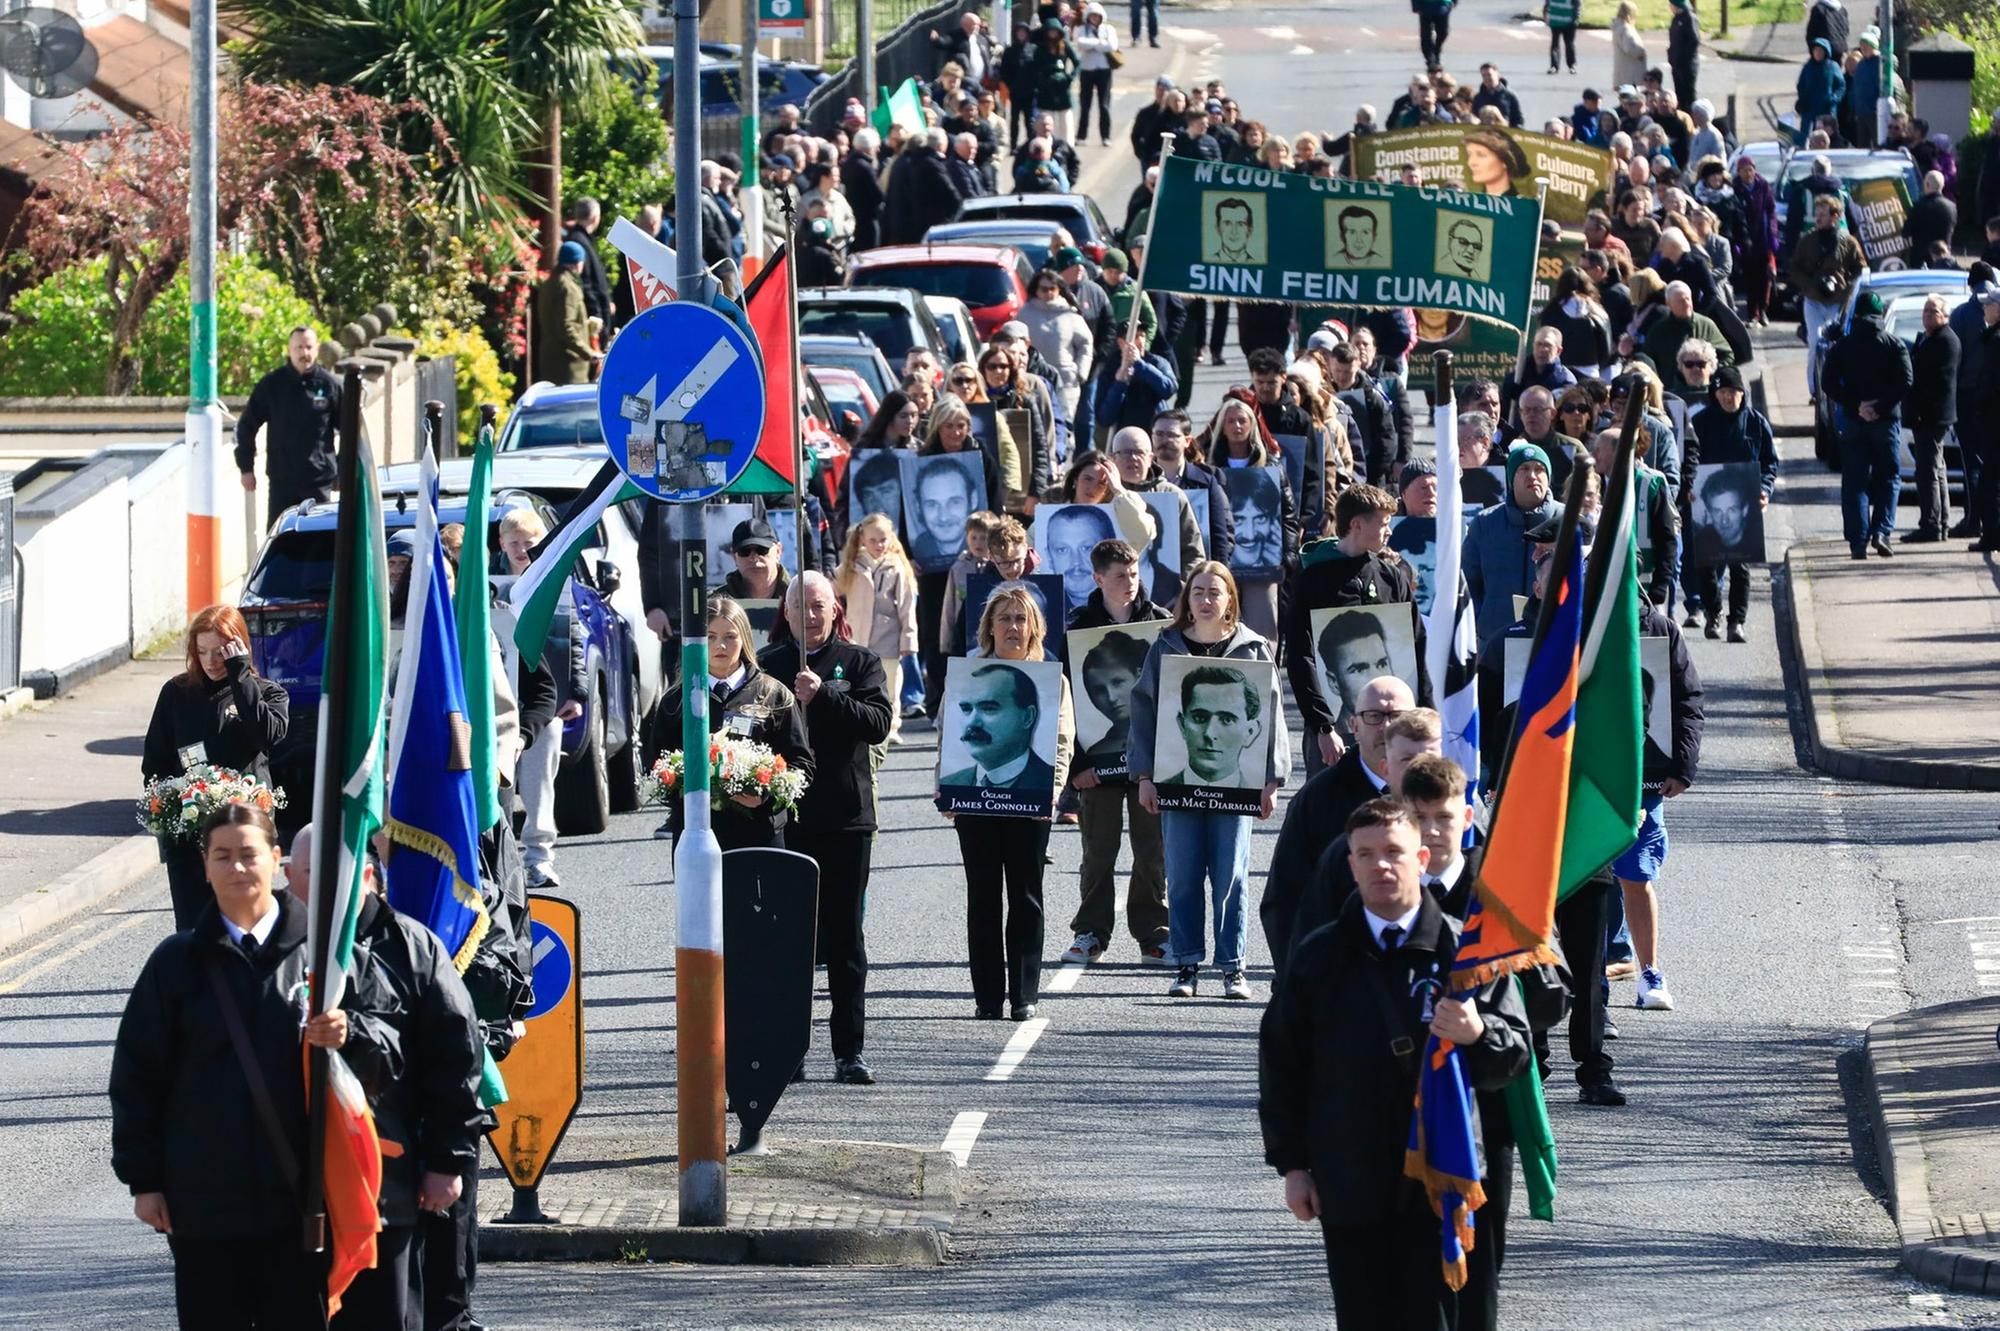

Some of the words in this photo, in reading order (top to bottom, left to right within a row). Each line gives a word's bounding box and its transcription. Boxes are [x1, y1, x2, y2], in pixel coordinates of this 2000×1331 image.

[1375, 146, 1460, 168] Constance
[1536, 152, 1600, 187] Culmore,
[1549, 172, 1588, 202] Derry
[1189, 264, 1264, 295] SINN
[1282, 271, 1359, 300] FEIN
[1376, 275, 1506, 316] CUMANN
